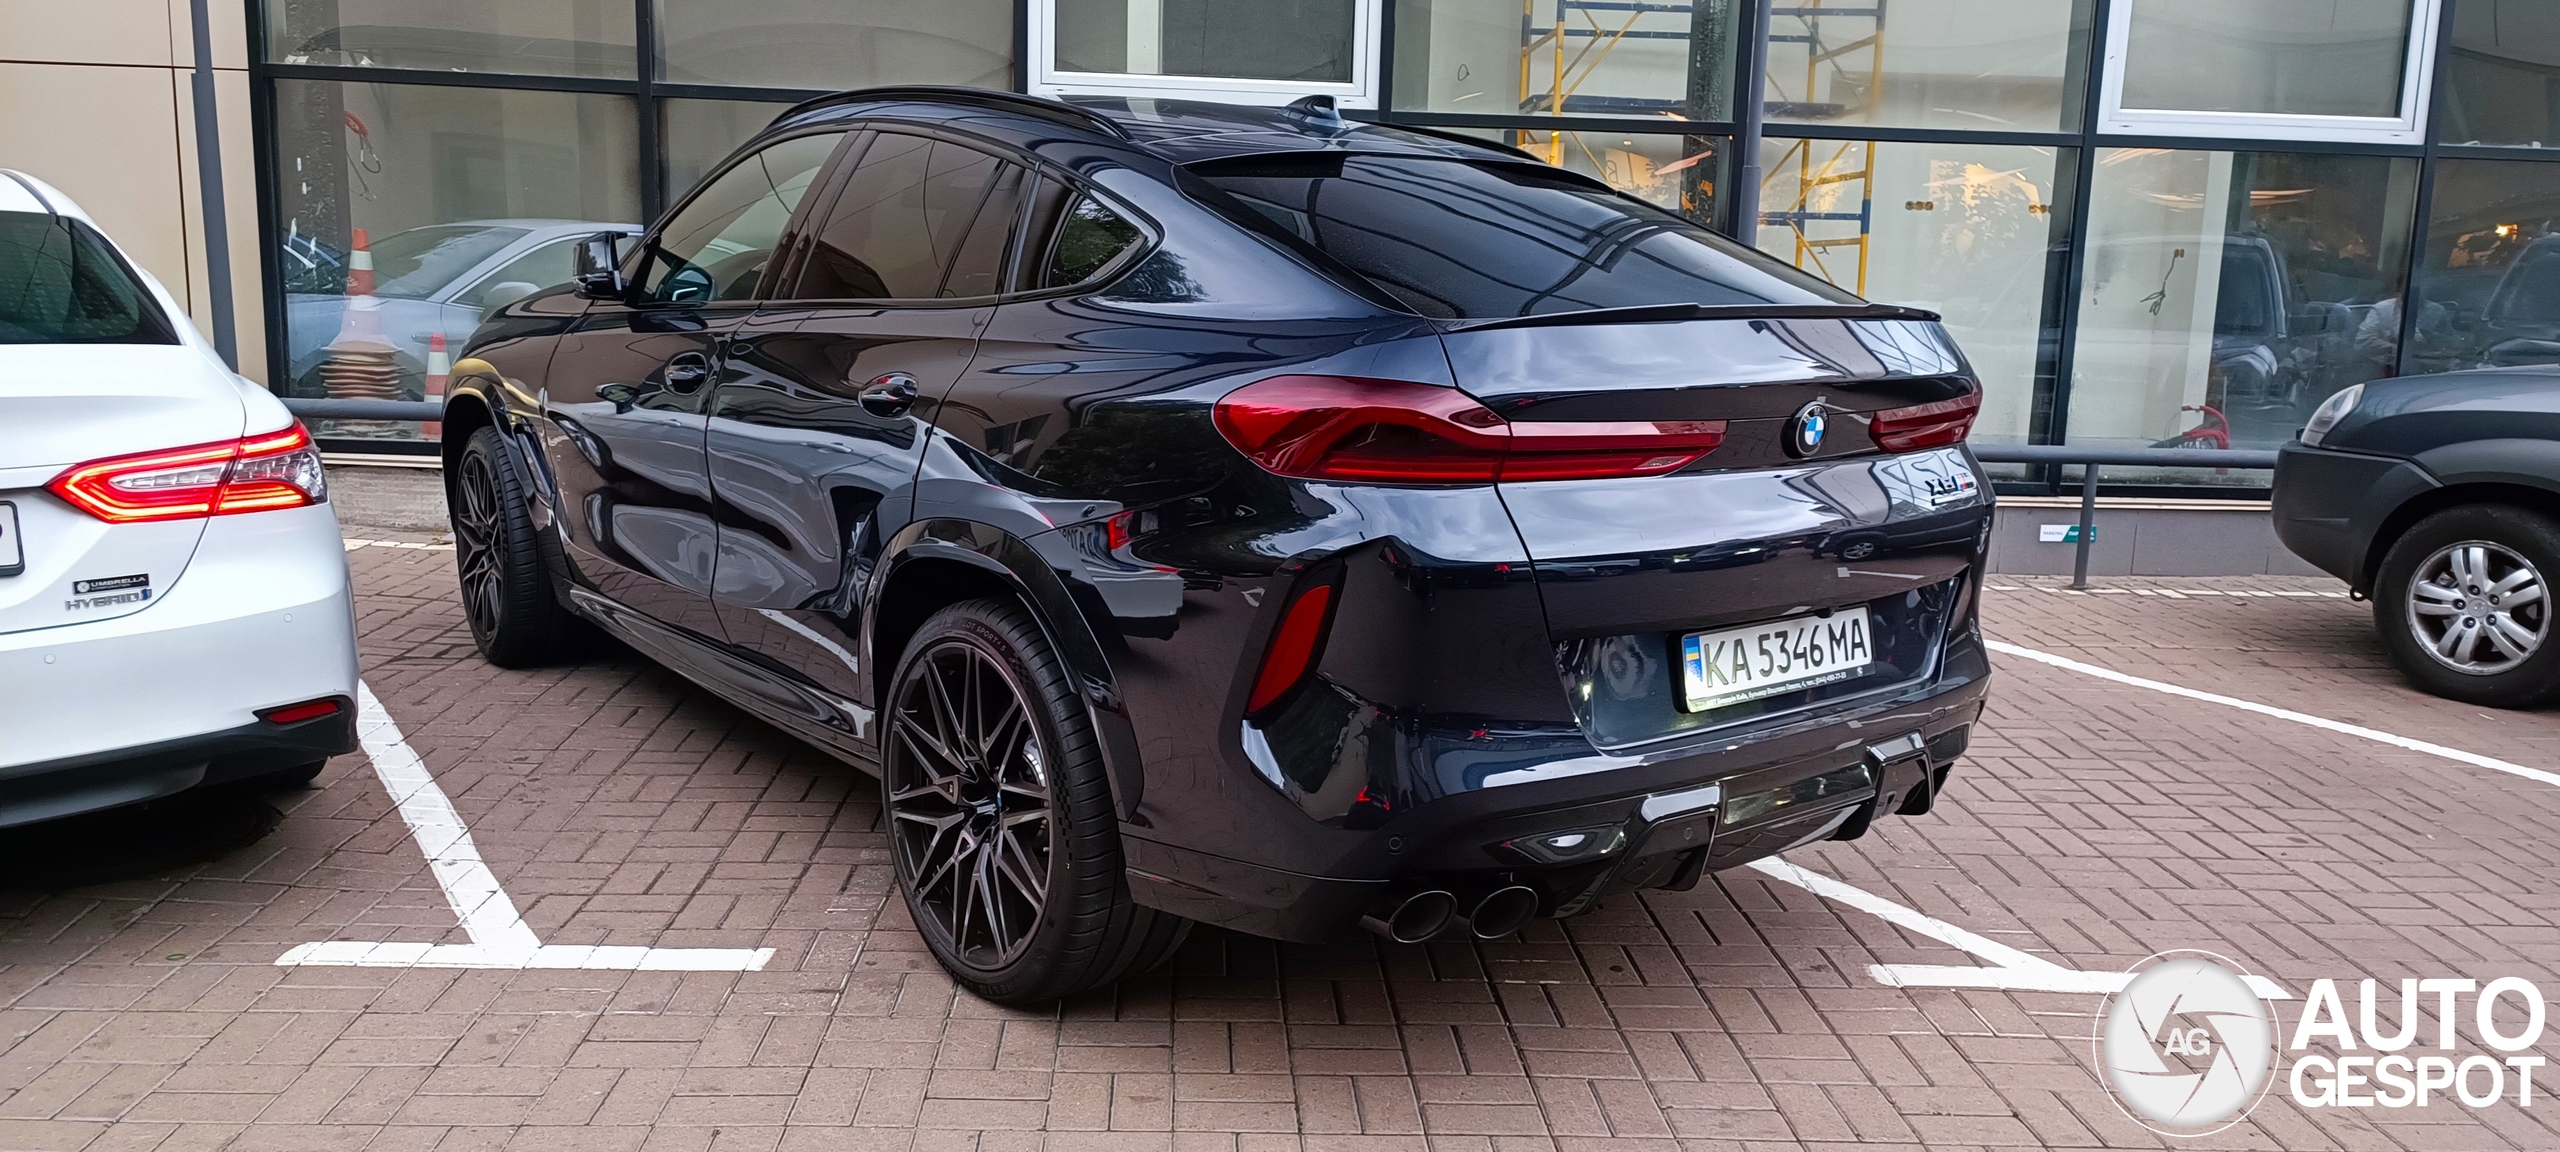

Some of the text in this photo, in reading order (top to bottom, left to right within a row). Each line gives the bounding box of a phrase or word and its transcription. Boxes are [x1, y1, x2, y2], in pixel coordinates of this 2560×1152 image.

[90, 576, 146, 587] UMBRELLA
[65, 593, 140, 611] HYBRID
[976, 625, 998, 643] SPORT
[1704, 618, 1868, 688] KA 5346 MA
